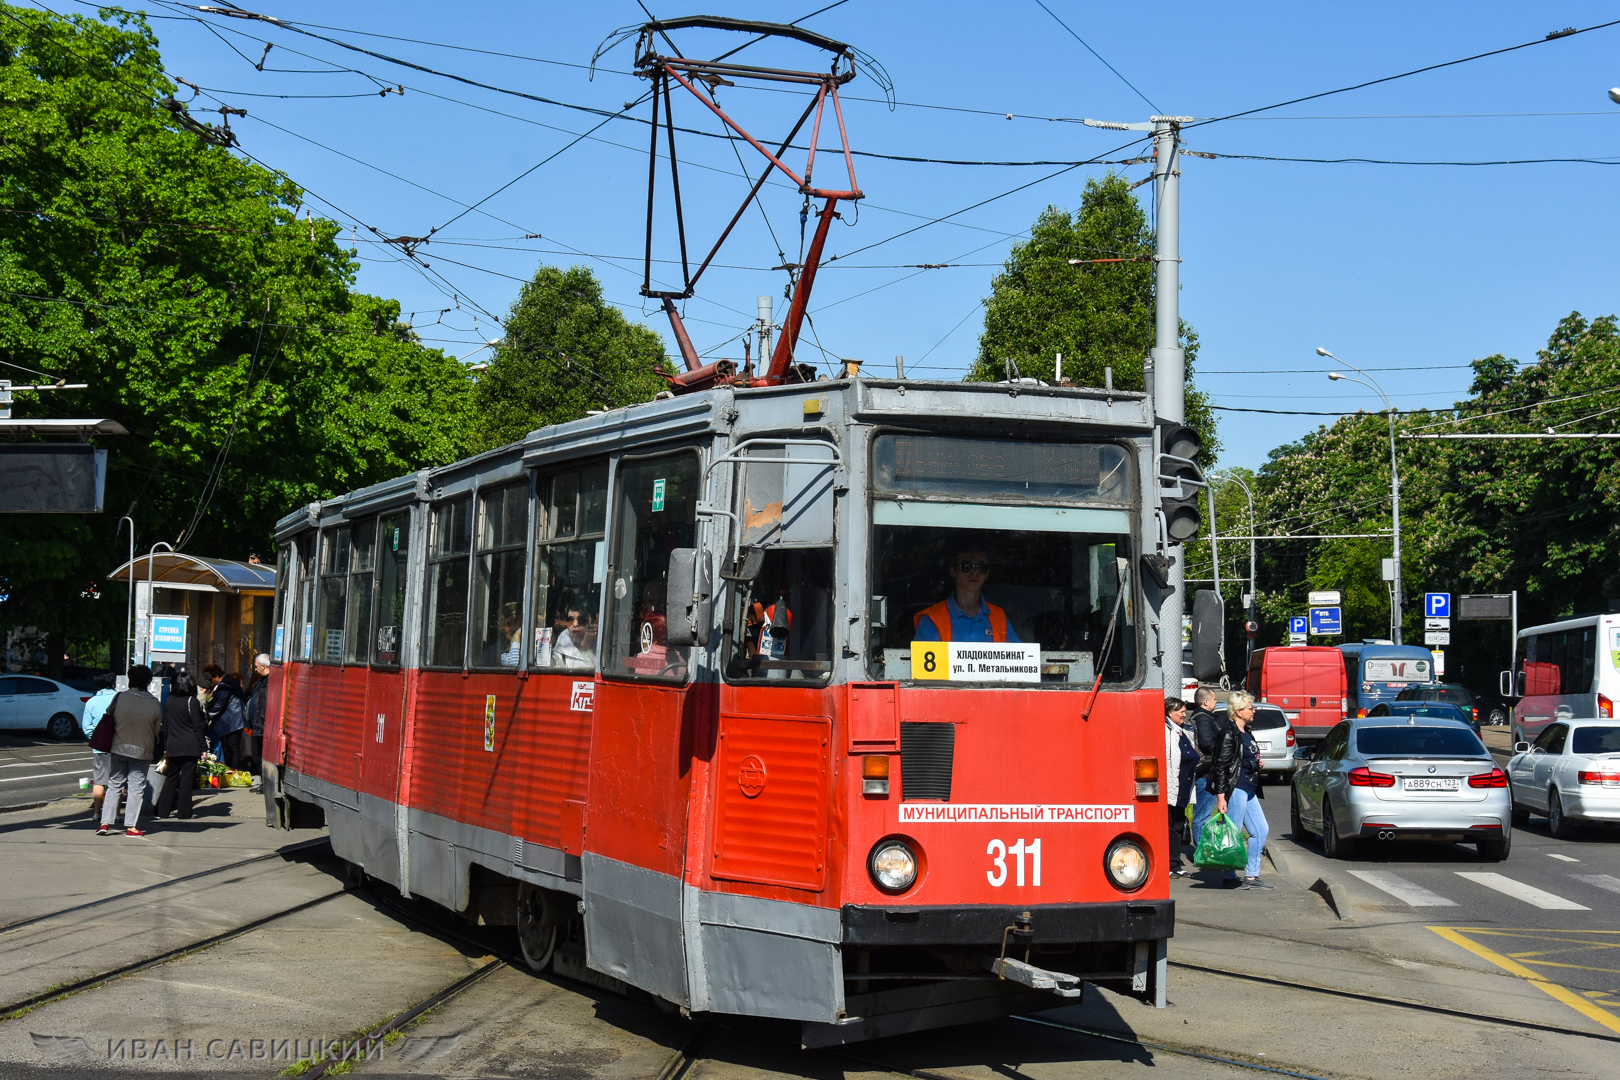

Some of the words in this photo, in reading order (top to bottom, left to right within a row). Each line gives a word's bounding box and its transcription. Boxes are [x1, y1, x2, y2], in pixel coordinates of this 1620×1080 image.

[1431, 595, 1446, 615] P
[158, 626, 180, 634] СТРЕЛКА
[1293, 618, 1305, 632] P
[154, 634, 183, 643] ОТКЛЮЧЕНА
[923, 650, 937, 673] 8
[956, 650, 1025, 661] ХЛАДОКОМБИНАТ
[952, 665, 965, 674] ул.
[967, 664, 976, 673] П.
[978, 664, 1038, 674] Метальникова
[375, 712, 386, 744] 311
[1407, 779, 1442, 788] А889СН
[1443, 779, 1456, 787] 123
[903, 805, 1044, 822] МУНИЦИПАЛЬНЫЙ
[1048, 807, 1130, 821] ТРАНСПОРТ
[986, 838, 1042, 888] 311
